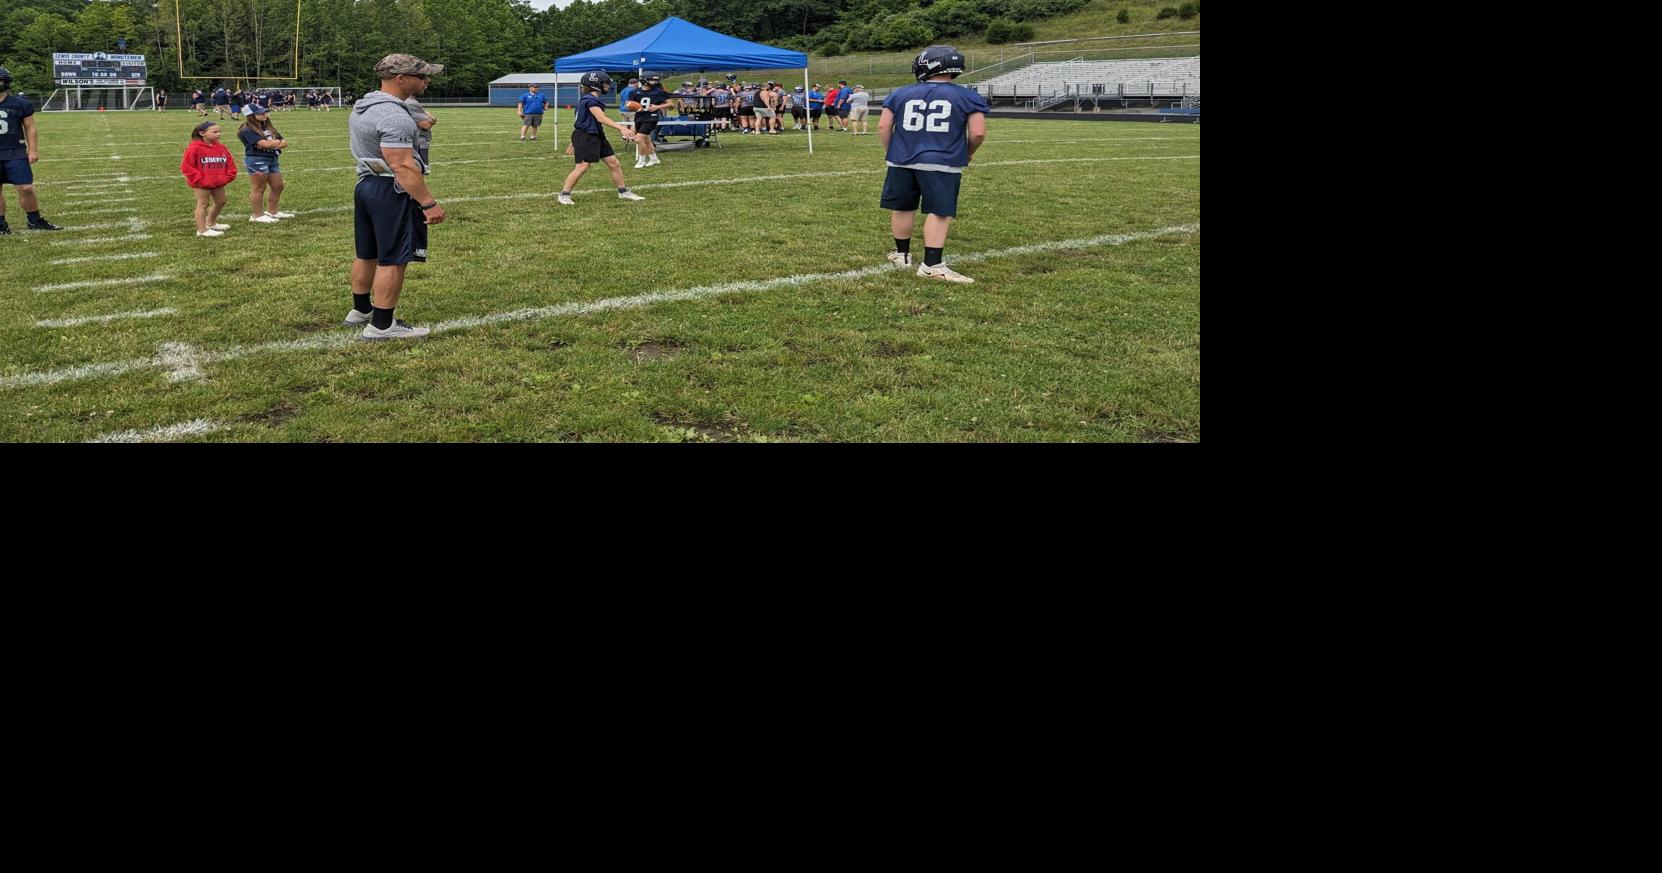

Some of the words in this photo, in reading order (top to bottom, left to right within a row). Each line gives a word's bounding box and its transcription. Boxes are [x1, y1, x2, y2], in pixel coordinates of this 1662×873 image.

[640, 97, 651, 112] 9
[902, 99, 952, 132] 62
[201, 156, 227, 164] LIBERTY
